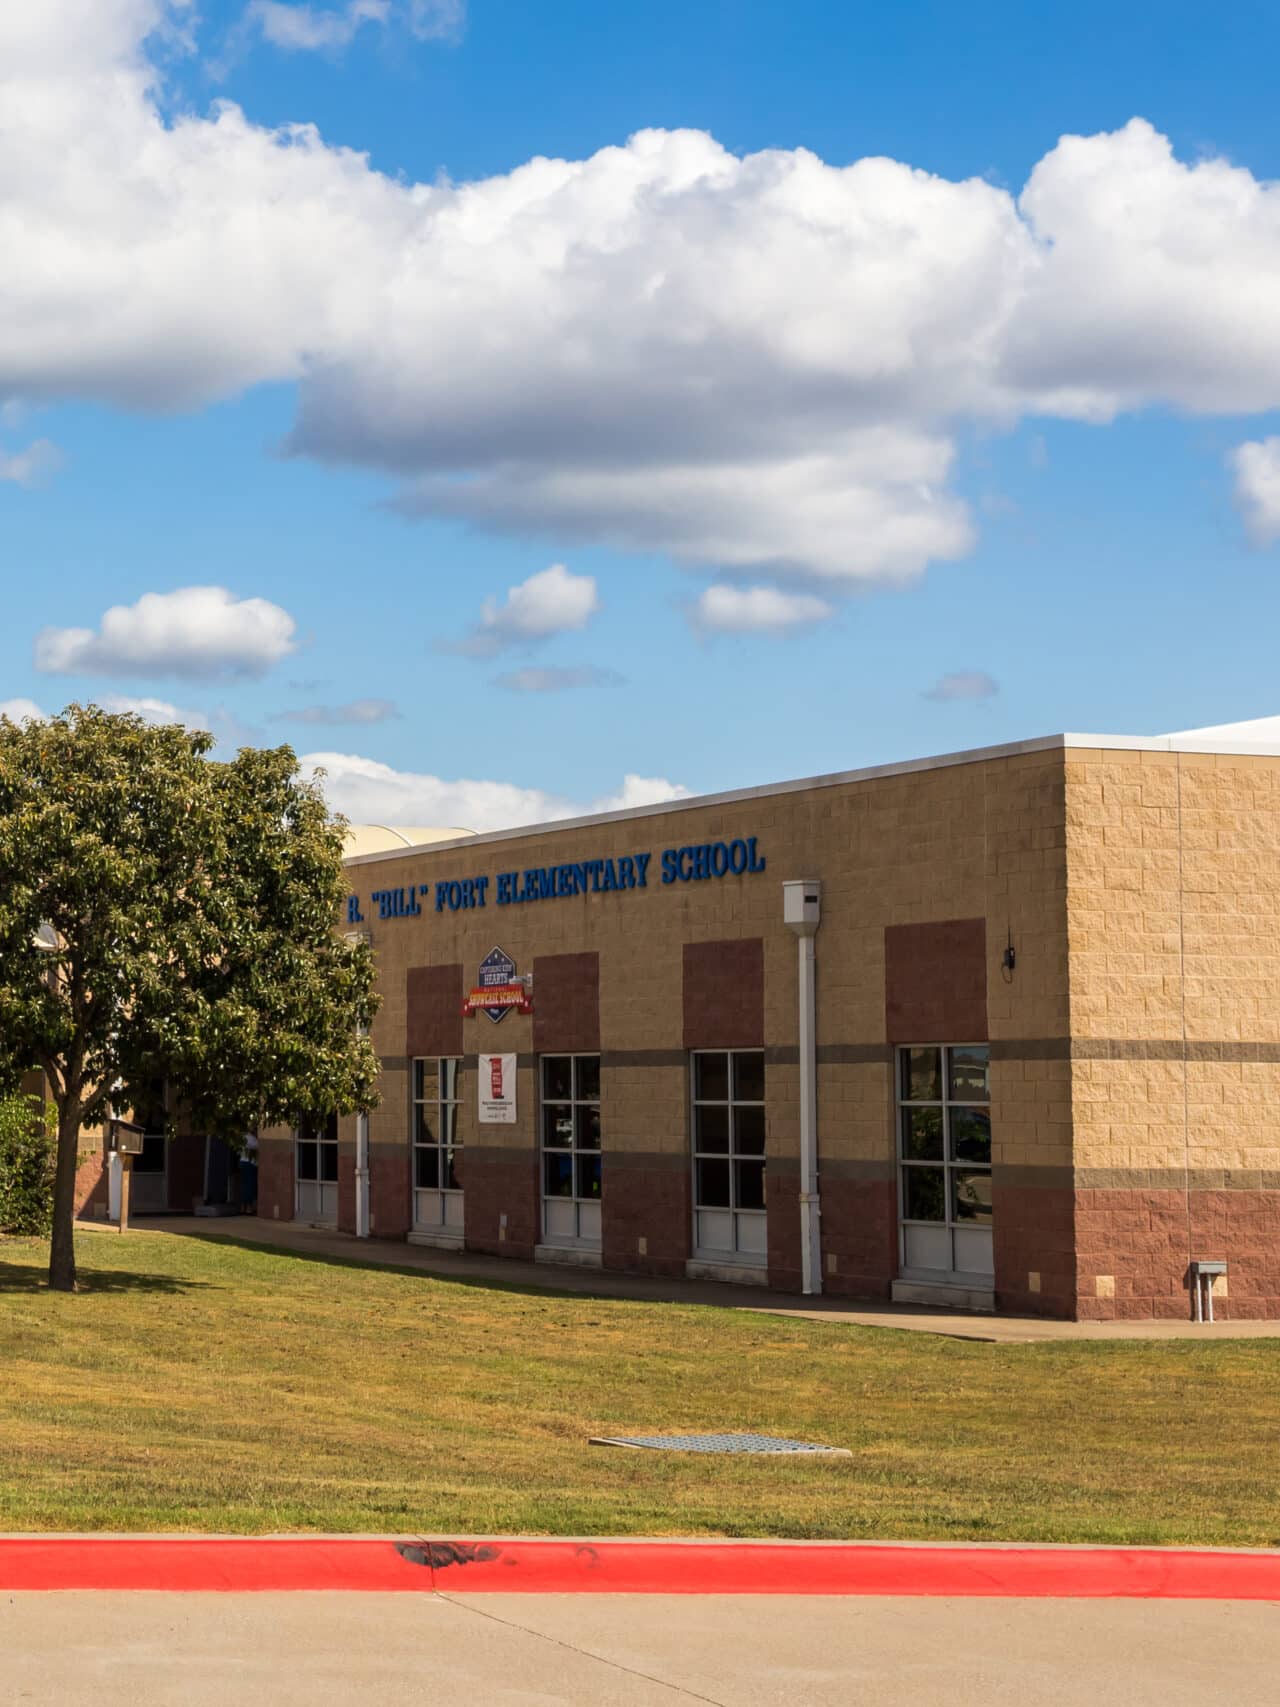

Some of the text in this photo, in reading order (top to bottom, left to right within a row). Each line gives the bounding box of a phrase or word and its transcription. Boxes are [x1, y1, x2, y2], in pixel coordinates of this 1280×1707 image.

[372, 884, 428, 919] "BILL"
[435, 876, 488, 912] FORT
[496, 853, 651, 904] ELEMENTARY
[662, 837, 766, 884] SCHOOL
[484, 972, 508, 985] HEARTS
[499, 991, 524, 1004] SCHOOL
